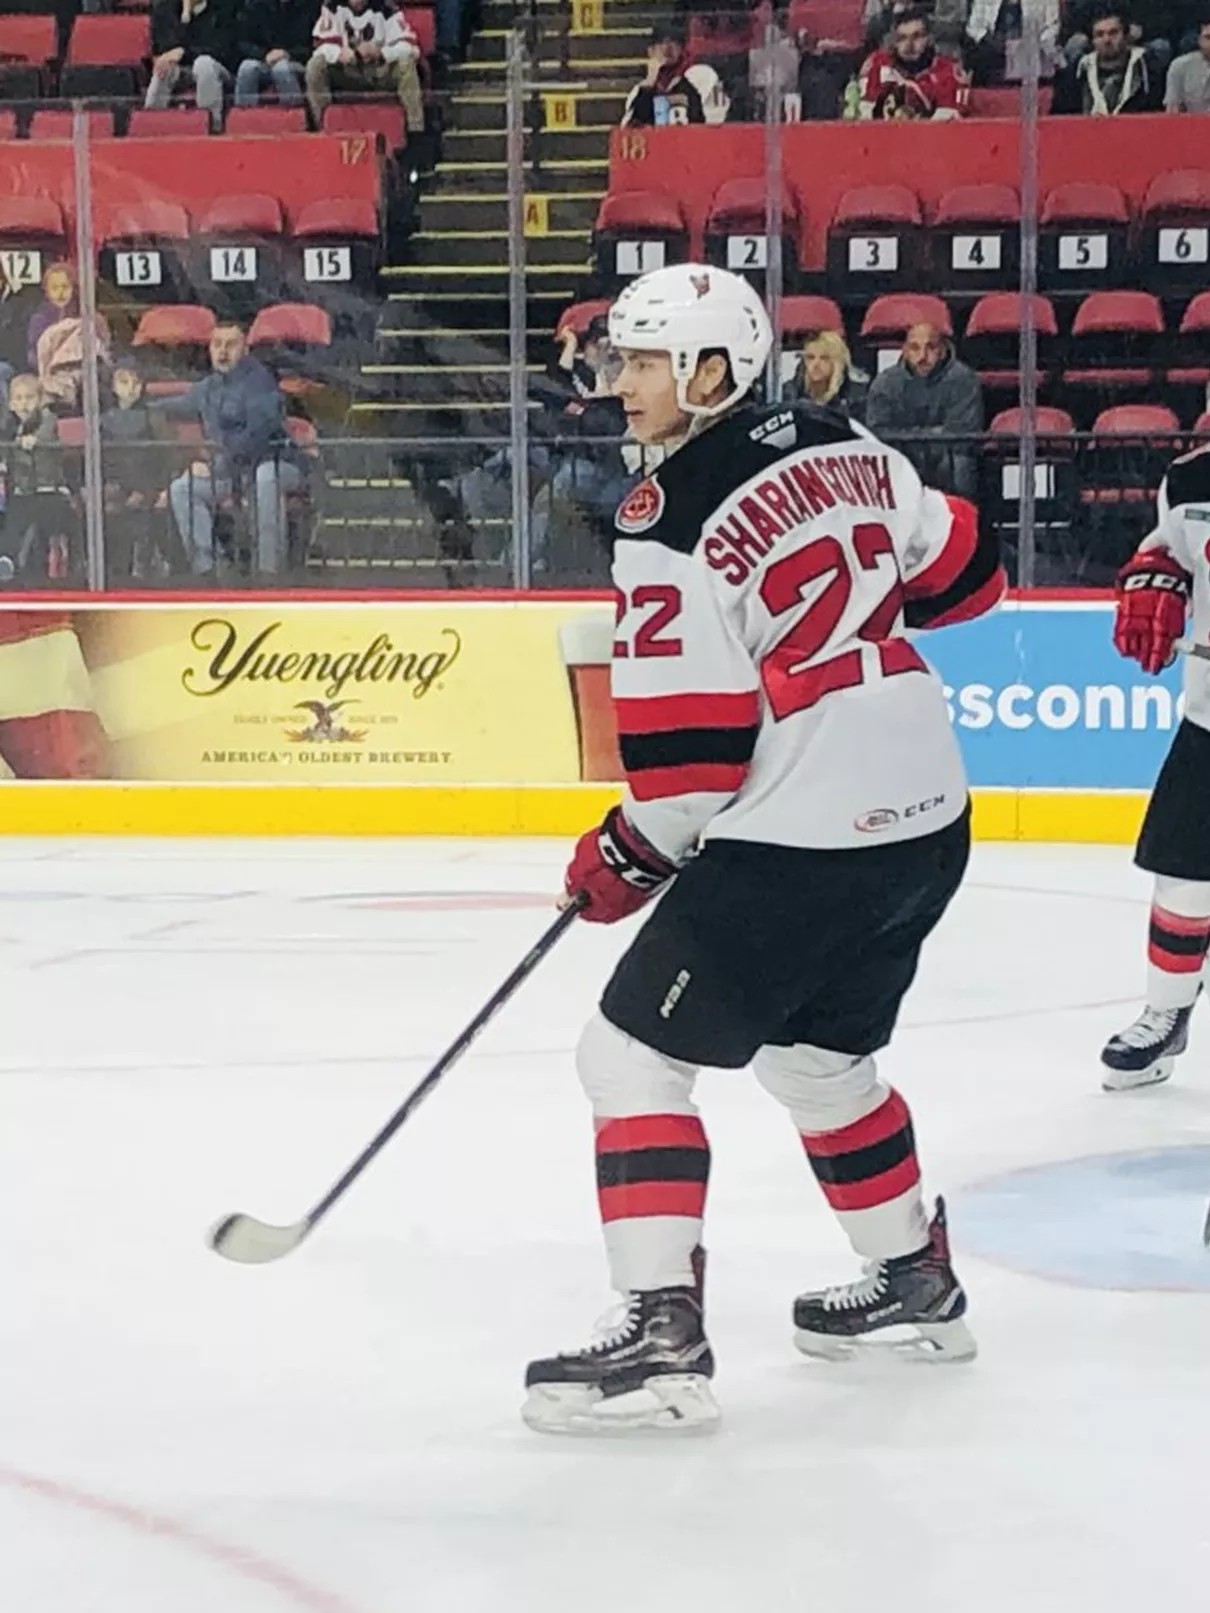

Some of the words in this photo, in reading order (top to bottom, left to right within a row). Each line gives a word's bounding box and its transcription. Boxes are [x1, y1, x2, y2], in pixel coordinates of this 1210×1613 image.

[338, 140, 368, 165] 17
[619, 137, 647, 161] 18
[527, 207, 540, 225] A
[634, 242, 644, 271] 1
[743, 239, 759, 265] 2
[865, 241, 881, 267] 3
[967, 238, 985, 265] 4
[1074, 237, 1091, 265] 5
[1174, 231, 1192, 259] 6
[7, 254, 32, 279] 12
[126, 255, 150, 281] 13
[222, 251, 248, 277] 14
[316, 250, 342, 277] 15
[748, 410, 794, 441] CCM
[758, 525, 930, 723] 22
[181, 618, 461, 699] Yuengling
[943, 683, 1187, 730] sconn
[298, 751, 363, 763] OLDEST
[368, 751, 452, 763] BREWERY
[904, 794, 946, 819] CCM
[599, 829, 668, 889] CC
